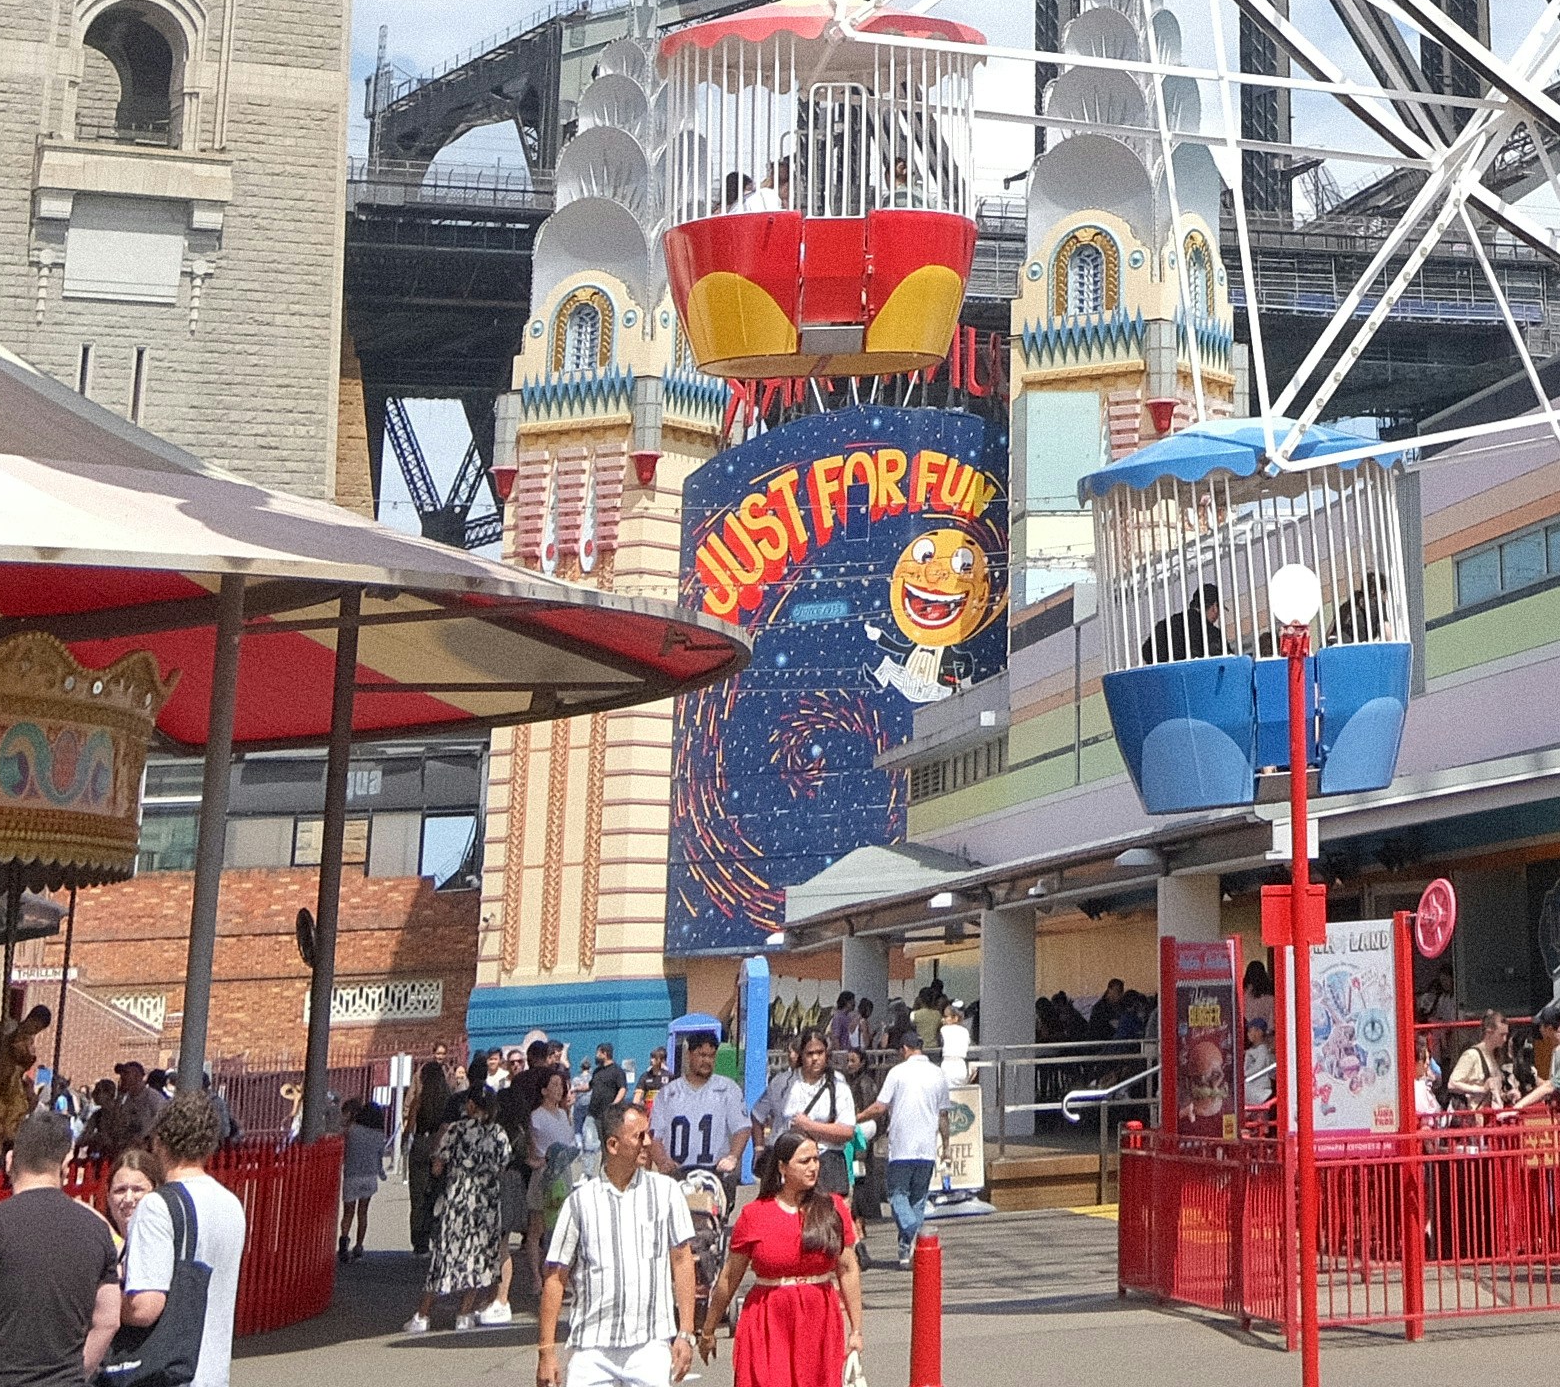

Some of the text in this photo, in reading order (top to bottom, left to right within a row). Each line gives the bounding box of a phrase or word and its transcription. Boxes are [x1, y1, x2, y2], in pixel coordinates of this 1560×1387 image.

[696, 448, 997, 617] JUST FOR FUN
[670, 1114, 714, 1165] 01
[936, 1143, 974, 1161] CFFEE
